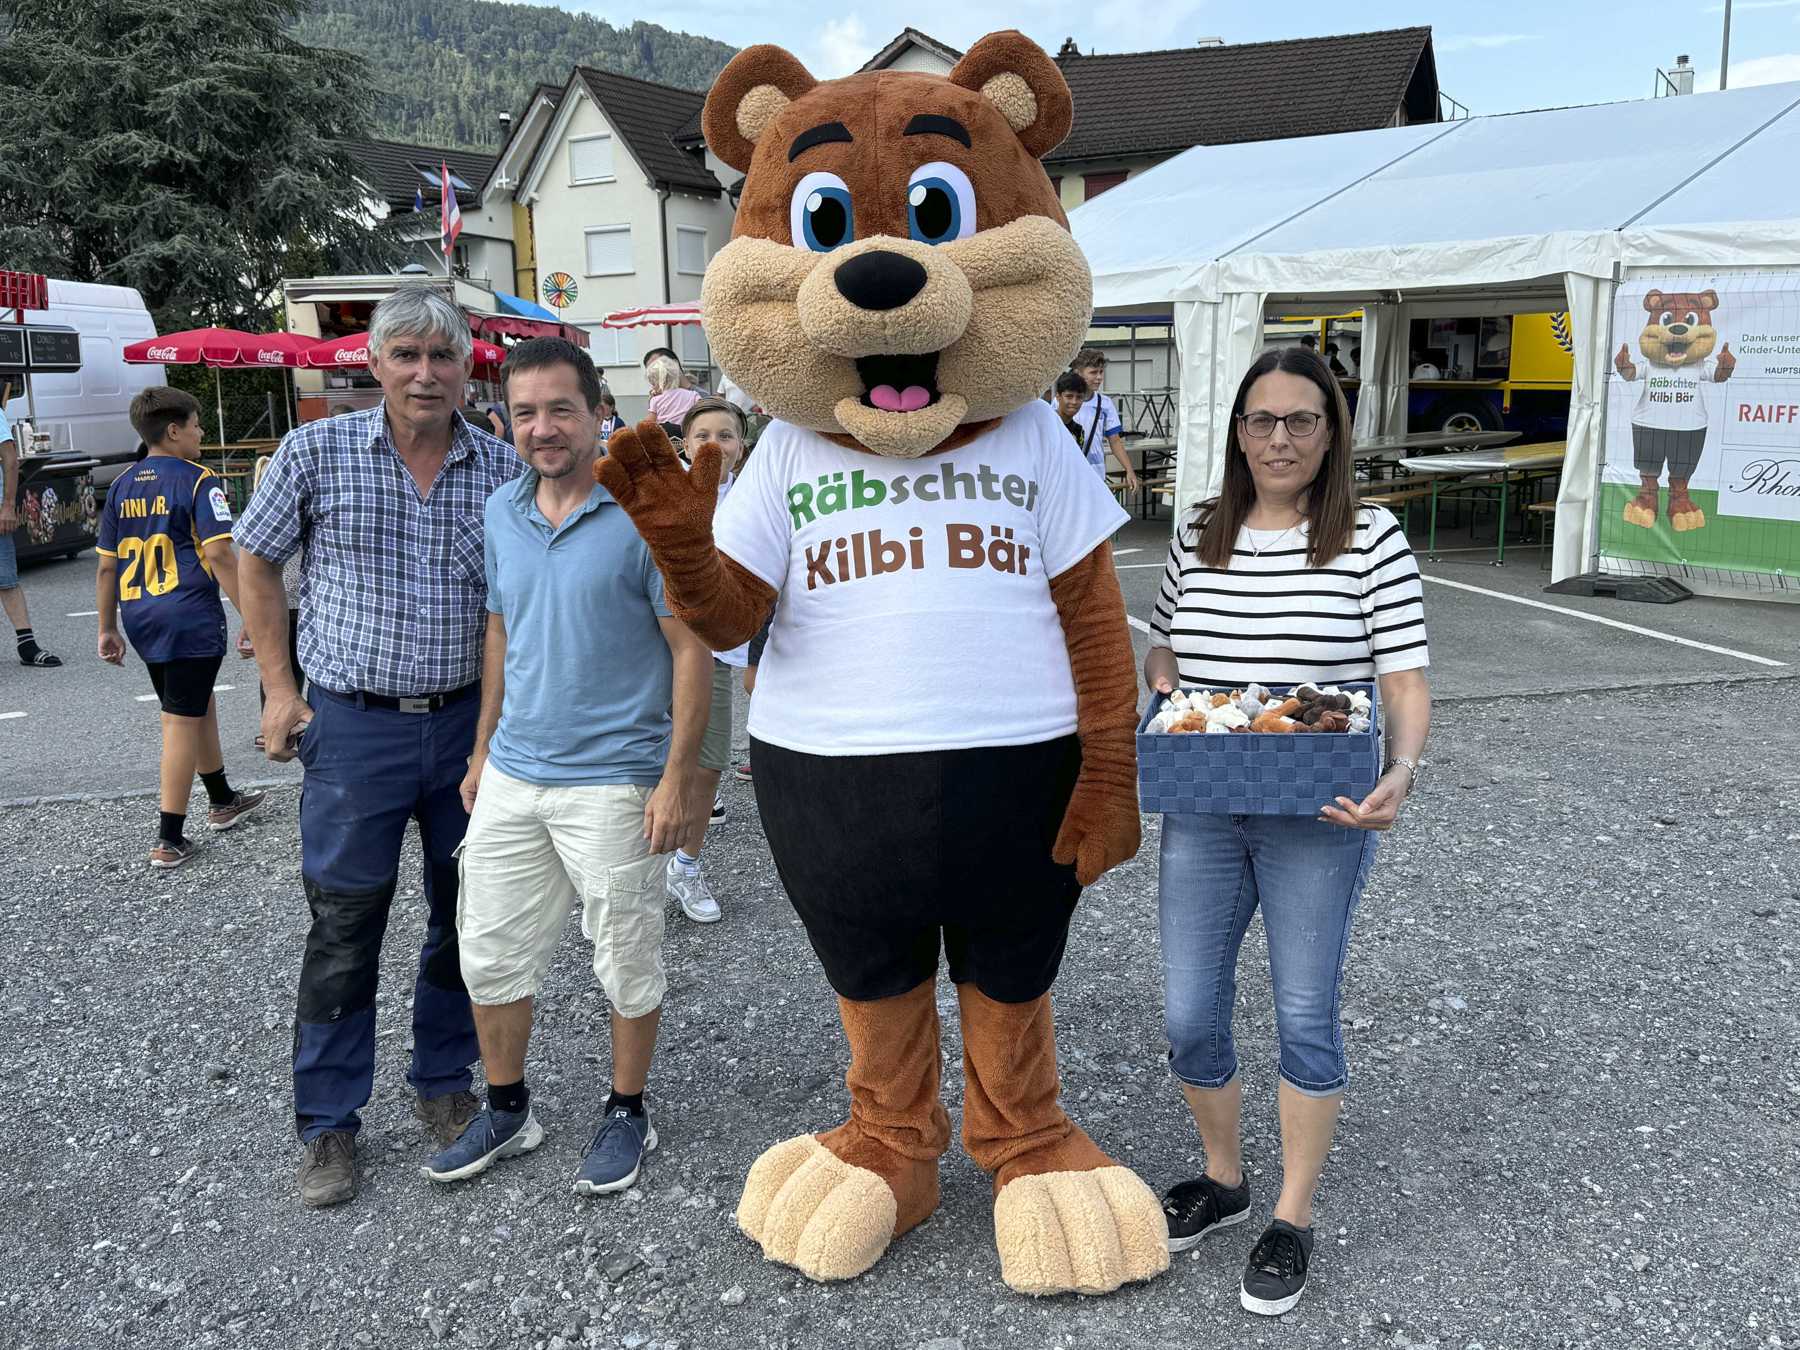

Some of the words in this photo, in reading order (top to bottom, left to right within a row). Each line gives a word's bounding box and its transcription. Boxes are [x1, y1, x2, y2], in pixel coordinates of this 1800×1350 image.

[1742, 334, 1767, 342] Dank
[1765, 367, 1800, 375] HAUPTS
[1650, 376, 1697, 389] Räbschter
[1650, 391, 1673, 403] Kilbi
[1675, 392, 1694, 403] Bär
[1738, 404, 1799, 424] RAIFF
[787, 462, 1039, 531] Räbschter
[804, 526, 925, 591] Kilbi
[945, 523, 1030, 576] Bär
[118, 533, 179, 601] 20
